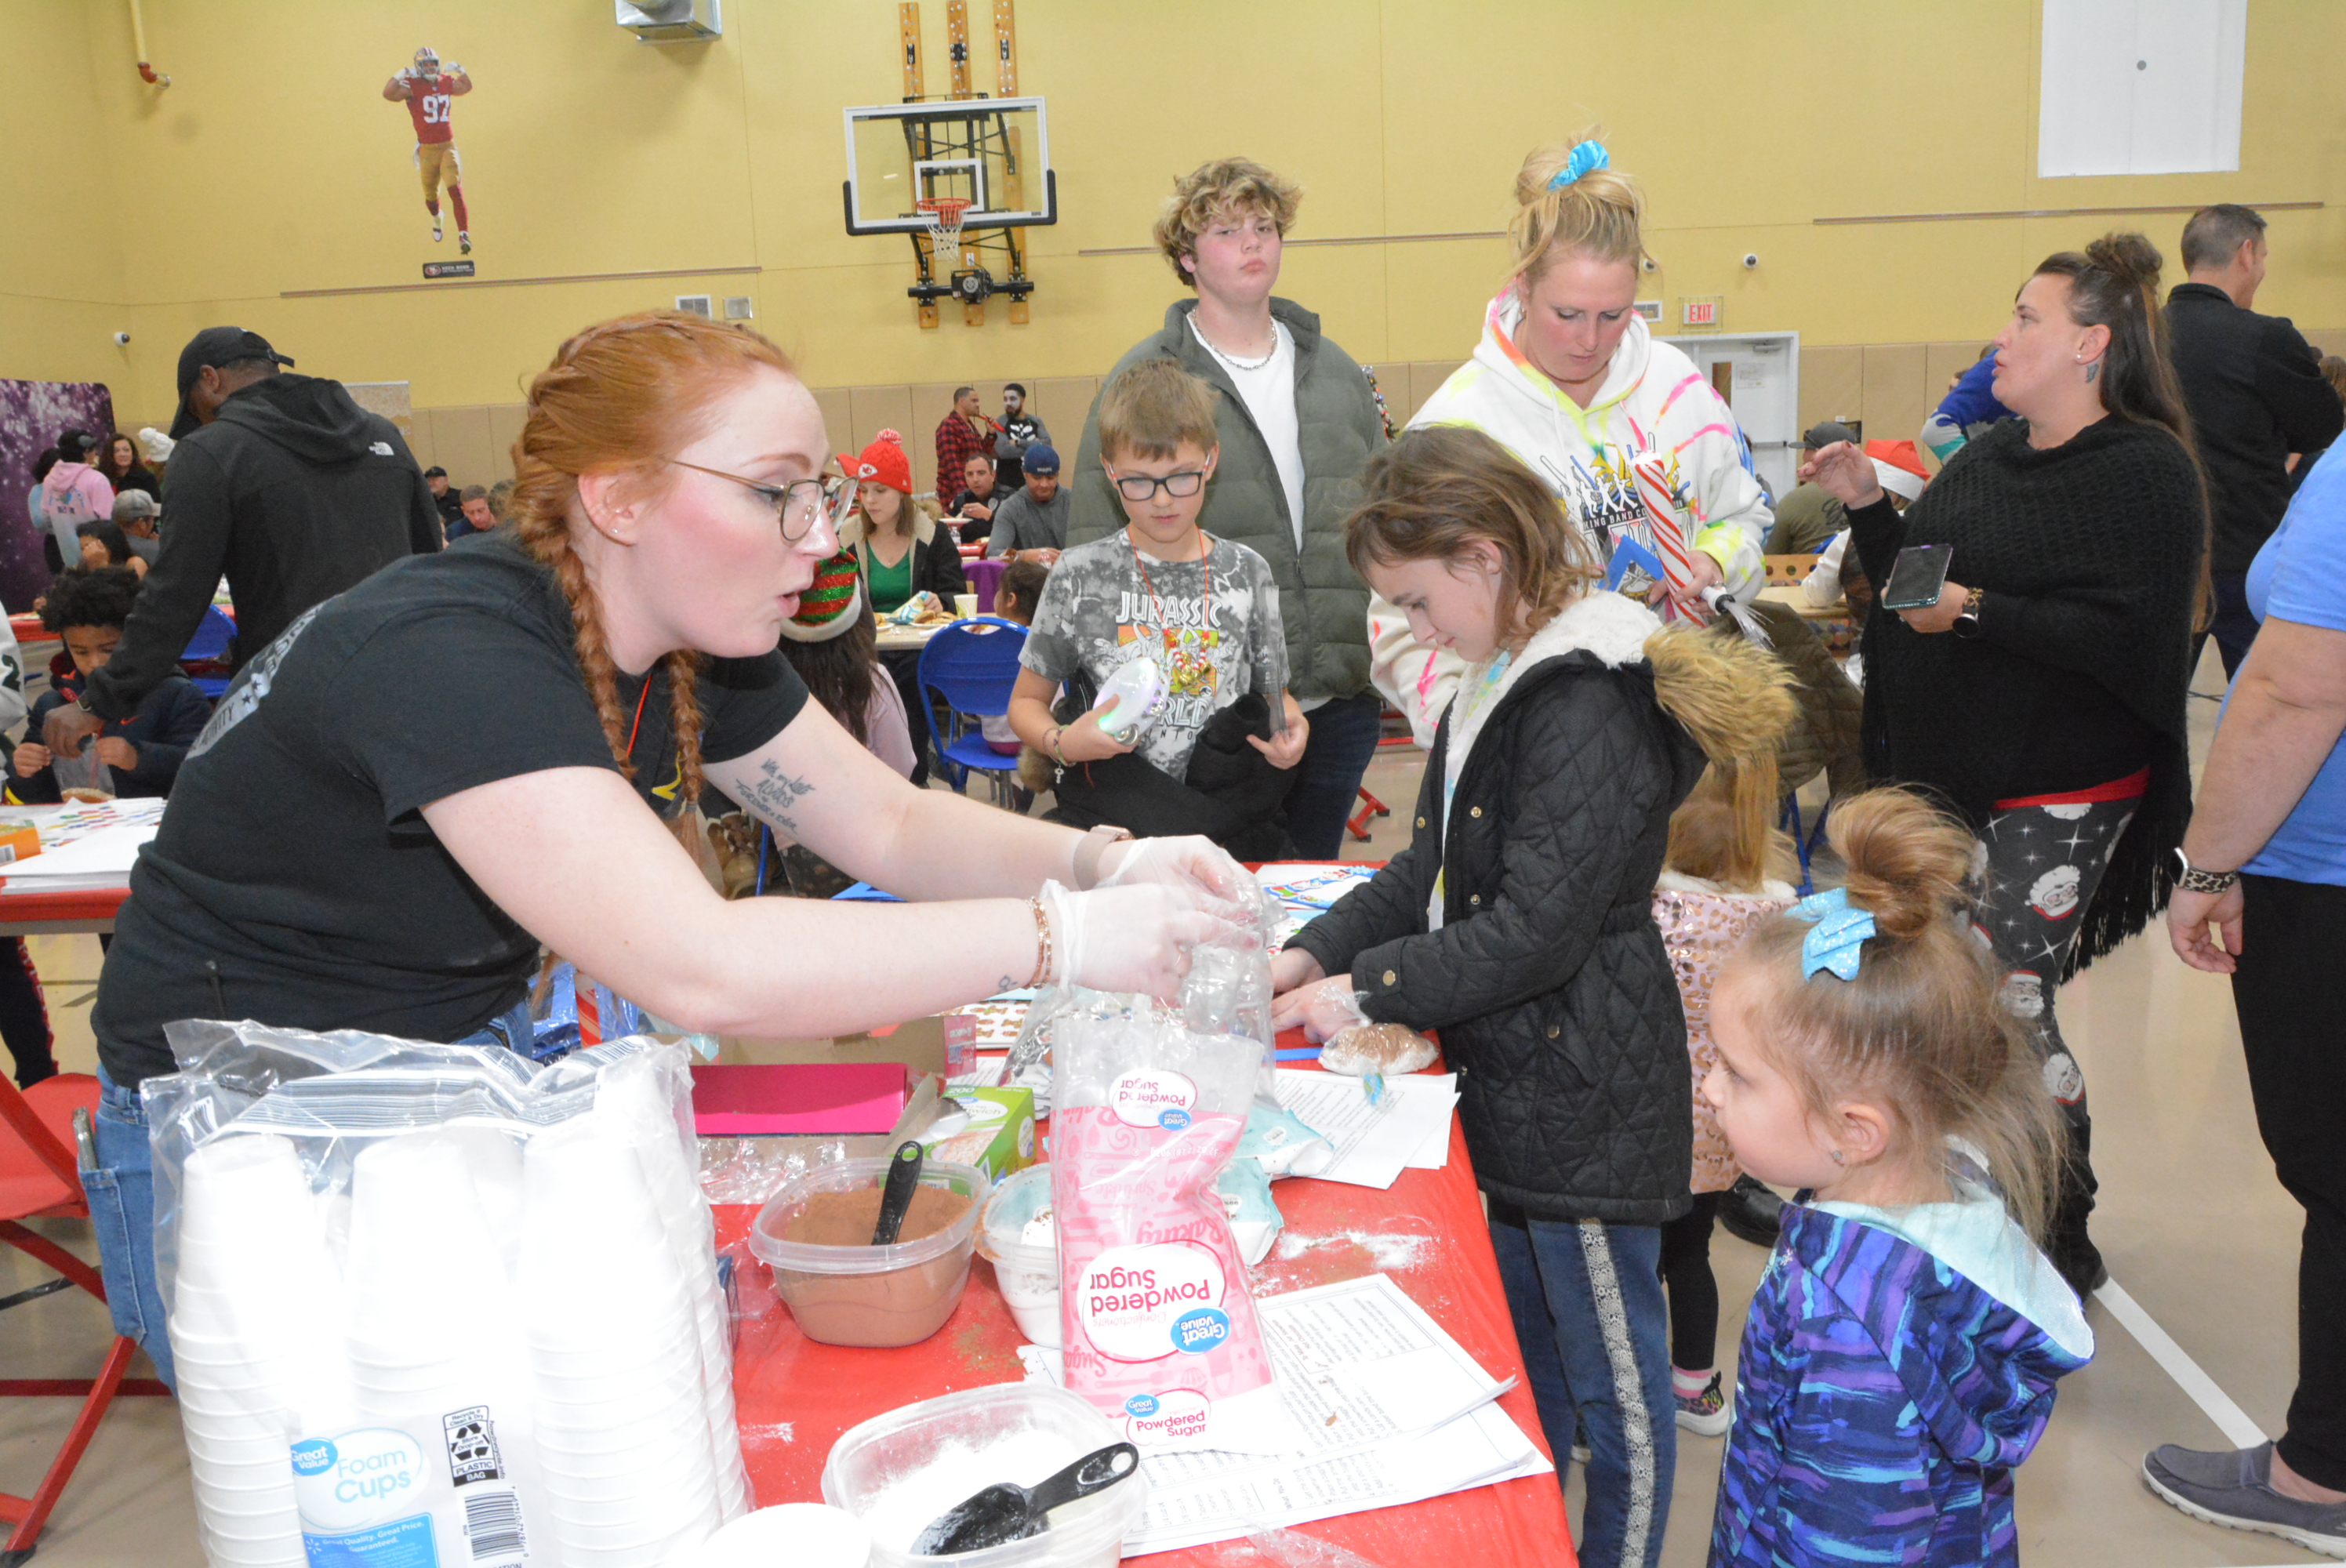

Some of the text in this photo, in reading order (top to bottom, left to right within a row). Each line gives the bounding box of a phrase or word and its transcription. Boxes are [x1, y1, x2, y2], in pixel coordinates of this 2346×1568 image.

[423, 94, 450, 123] 97
[1690, 303, 1712, 321] EXIT
[1610, 512, 1633, 524] BAND
[1115, 590, 1222, 628] JURASSIC
[1158, 697, 1211, 728] RLD
[1121, 1078, 1158, 1092] Sugar
[1164, 1117, 1188, 1127] Great
[1173, 1147, 1187, 1157] LB)
[1209, 1147, 1218, 1156] 32
[1136, 1216, 1223, 1247] Baking
[1089, 1267, 1156, 1290] Sugar
[1090, 1279, 1211, 1316] Powdered
[1180, 1316, 1214, 1330] Value
[1181, 1323, 1226, 1346] Great
[1128, 1398, 1153, 1408] Great
[452, 1410, 475, 1421] Recycle
[1136, 1410, 1205, 1432] Powdered
[1168, 1423, 1207, 1437] Sugar
[458, 1439, 484, 1451] Drop-off
[461, 1436, 478, 1444] Store
[291, 1446, 328, 1462] Great
[298, 1457, 329, 1469] Value
[336, 1450, 407, 1479] Foam
[456, 1461, 493, 1475] PLASTIC
[467, 1472, 485, 1481] BAG
[335, 1470, 412, 1504] Cups
[344, 1534, 376, 1546] Quality.
[378, 1528, 401, 1538] Great
[401, 1521, 425, 1531] Price.
[349, 1537, 399, 1552] Guaranteed.
